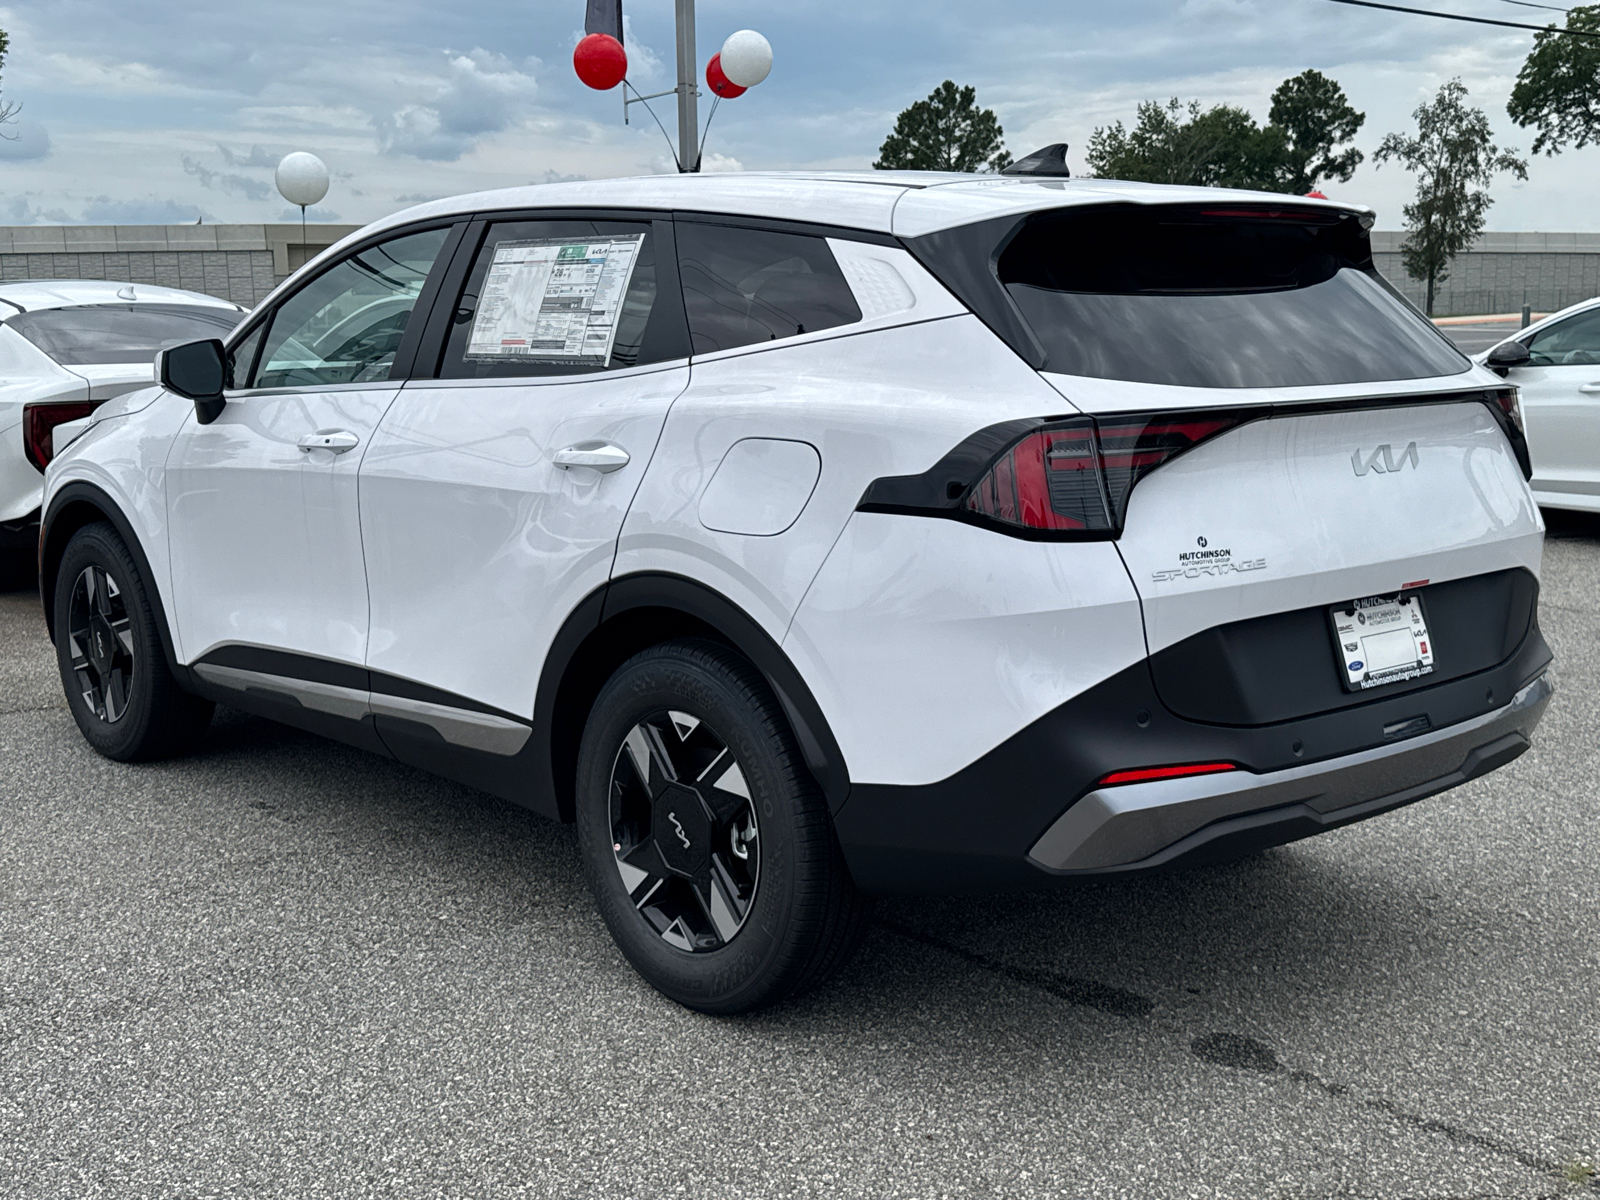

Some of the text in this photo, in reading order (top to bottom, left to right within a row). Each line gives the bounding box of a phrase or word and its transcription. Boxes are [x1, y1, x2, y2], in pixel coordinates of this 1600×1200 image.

[1351, 441, 1420, 477] KIA
[1179, 549, 1231, 561] HUTCHINSON
[1181, 559, 1213, 567] AUTOMOTIVE
[1151, 558, 1268, 582] SPORTAGE
[730, 724, 774, 818] KUMHO
